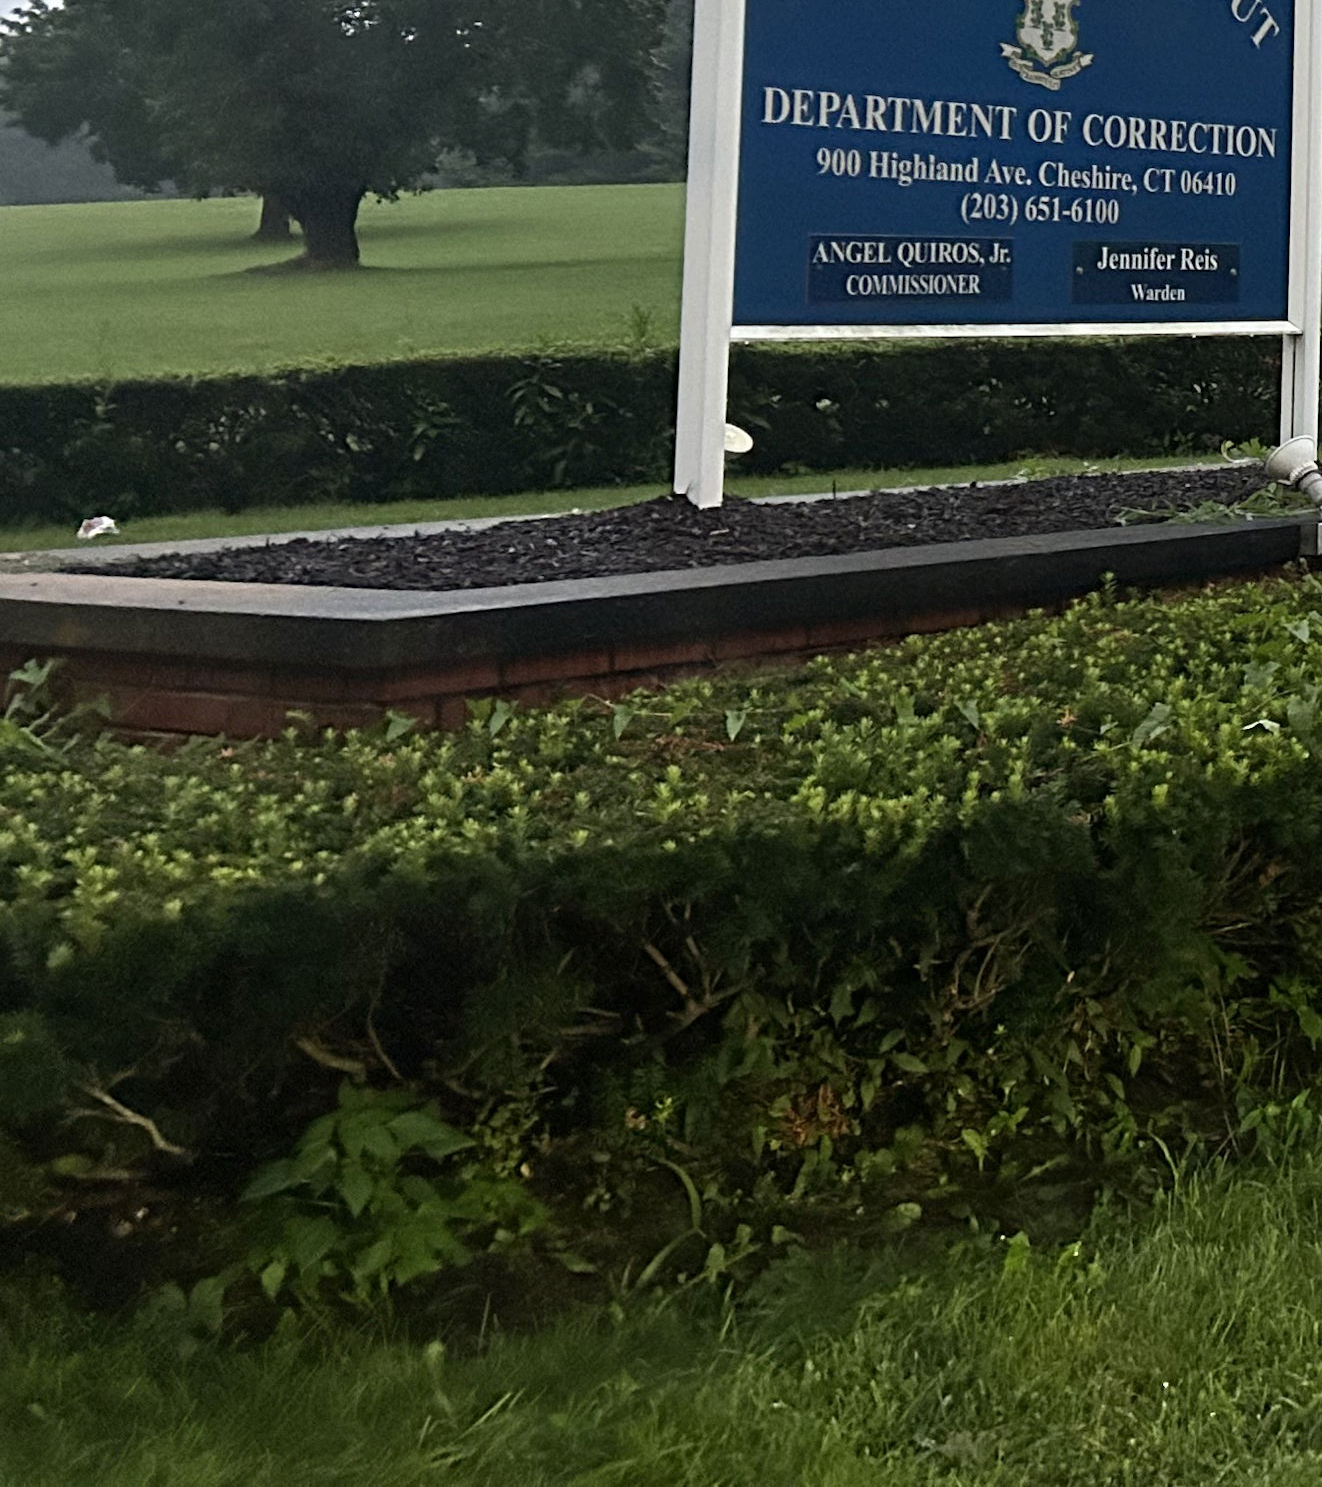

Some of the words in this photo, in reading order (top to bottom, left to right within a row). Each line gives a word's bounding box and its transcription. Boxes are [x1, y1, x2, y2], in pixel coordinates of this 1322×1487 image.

[762, 86, 1017, 141] DEPARTMENT
[1028, 108, 1072, 144] OF
[1082, 113, 1277, 159] CORRECTION
[816, 147, 861, 177] 900
[869, 151, 979, 186] Highland
[984, 159, 1032, 186] Ave.
[1038, 161, 1138, 194] Cheshire,
[1143, 167, 1176, 193] CT
[1180, 170, 1236, 196] 06410
[961, 192, 1019, 224] (203)
[1025, 196, 1119, 224] 651-6100
[812, 241, 892, 263] ANGEL
[897, 241, 985, 268] QUIROS,
[989, 242, 1012, 263] Jr.
[1097, 246, 1176, 270] Jennifer
[1180, 248, 1218, 271] Reis
[846, 274, 981, 296] COMMISSIONER
[1131, 283, 1186, 302] Warden
